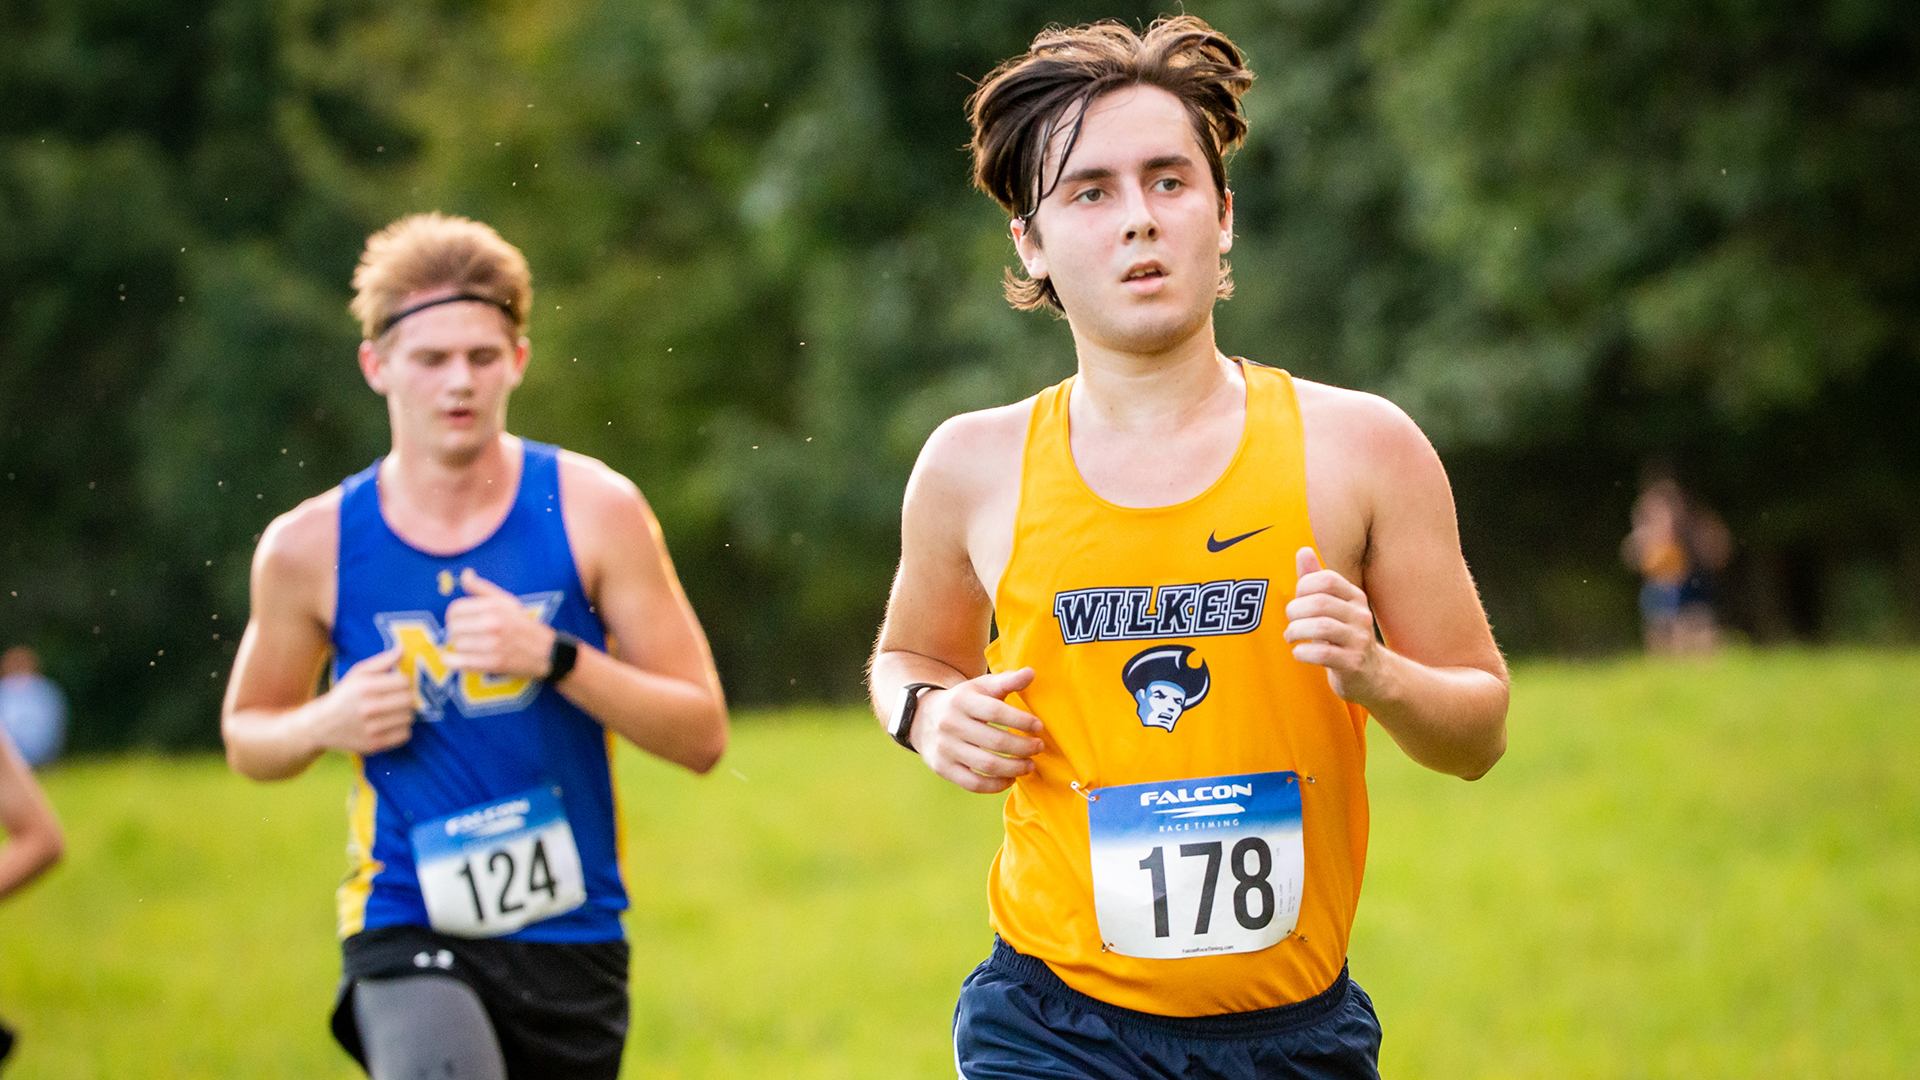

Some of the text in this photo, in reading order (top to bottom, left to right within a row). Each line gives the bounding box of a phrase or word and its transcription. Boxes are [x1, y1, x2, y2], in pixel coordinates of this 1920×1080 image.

[1053, 579, 1269, 645] WILKES
[1140, 783, 1252, 806] FALCON
[1159, 818, 1240, 833] RACE TIMING
[458, 838, 556, 922] 124
[1138, 836, 1276, 938] 178
